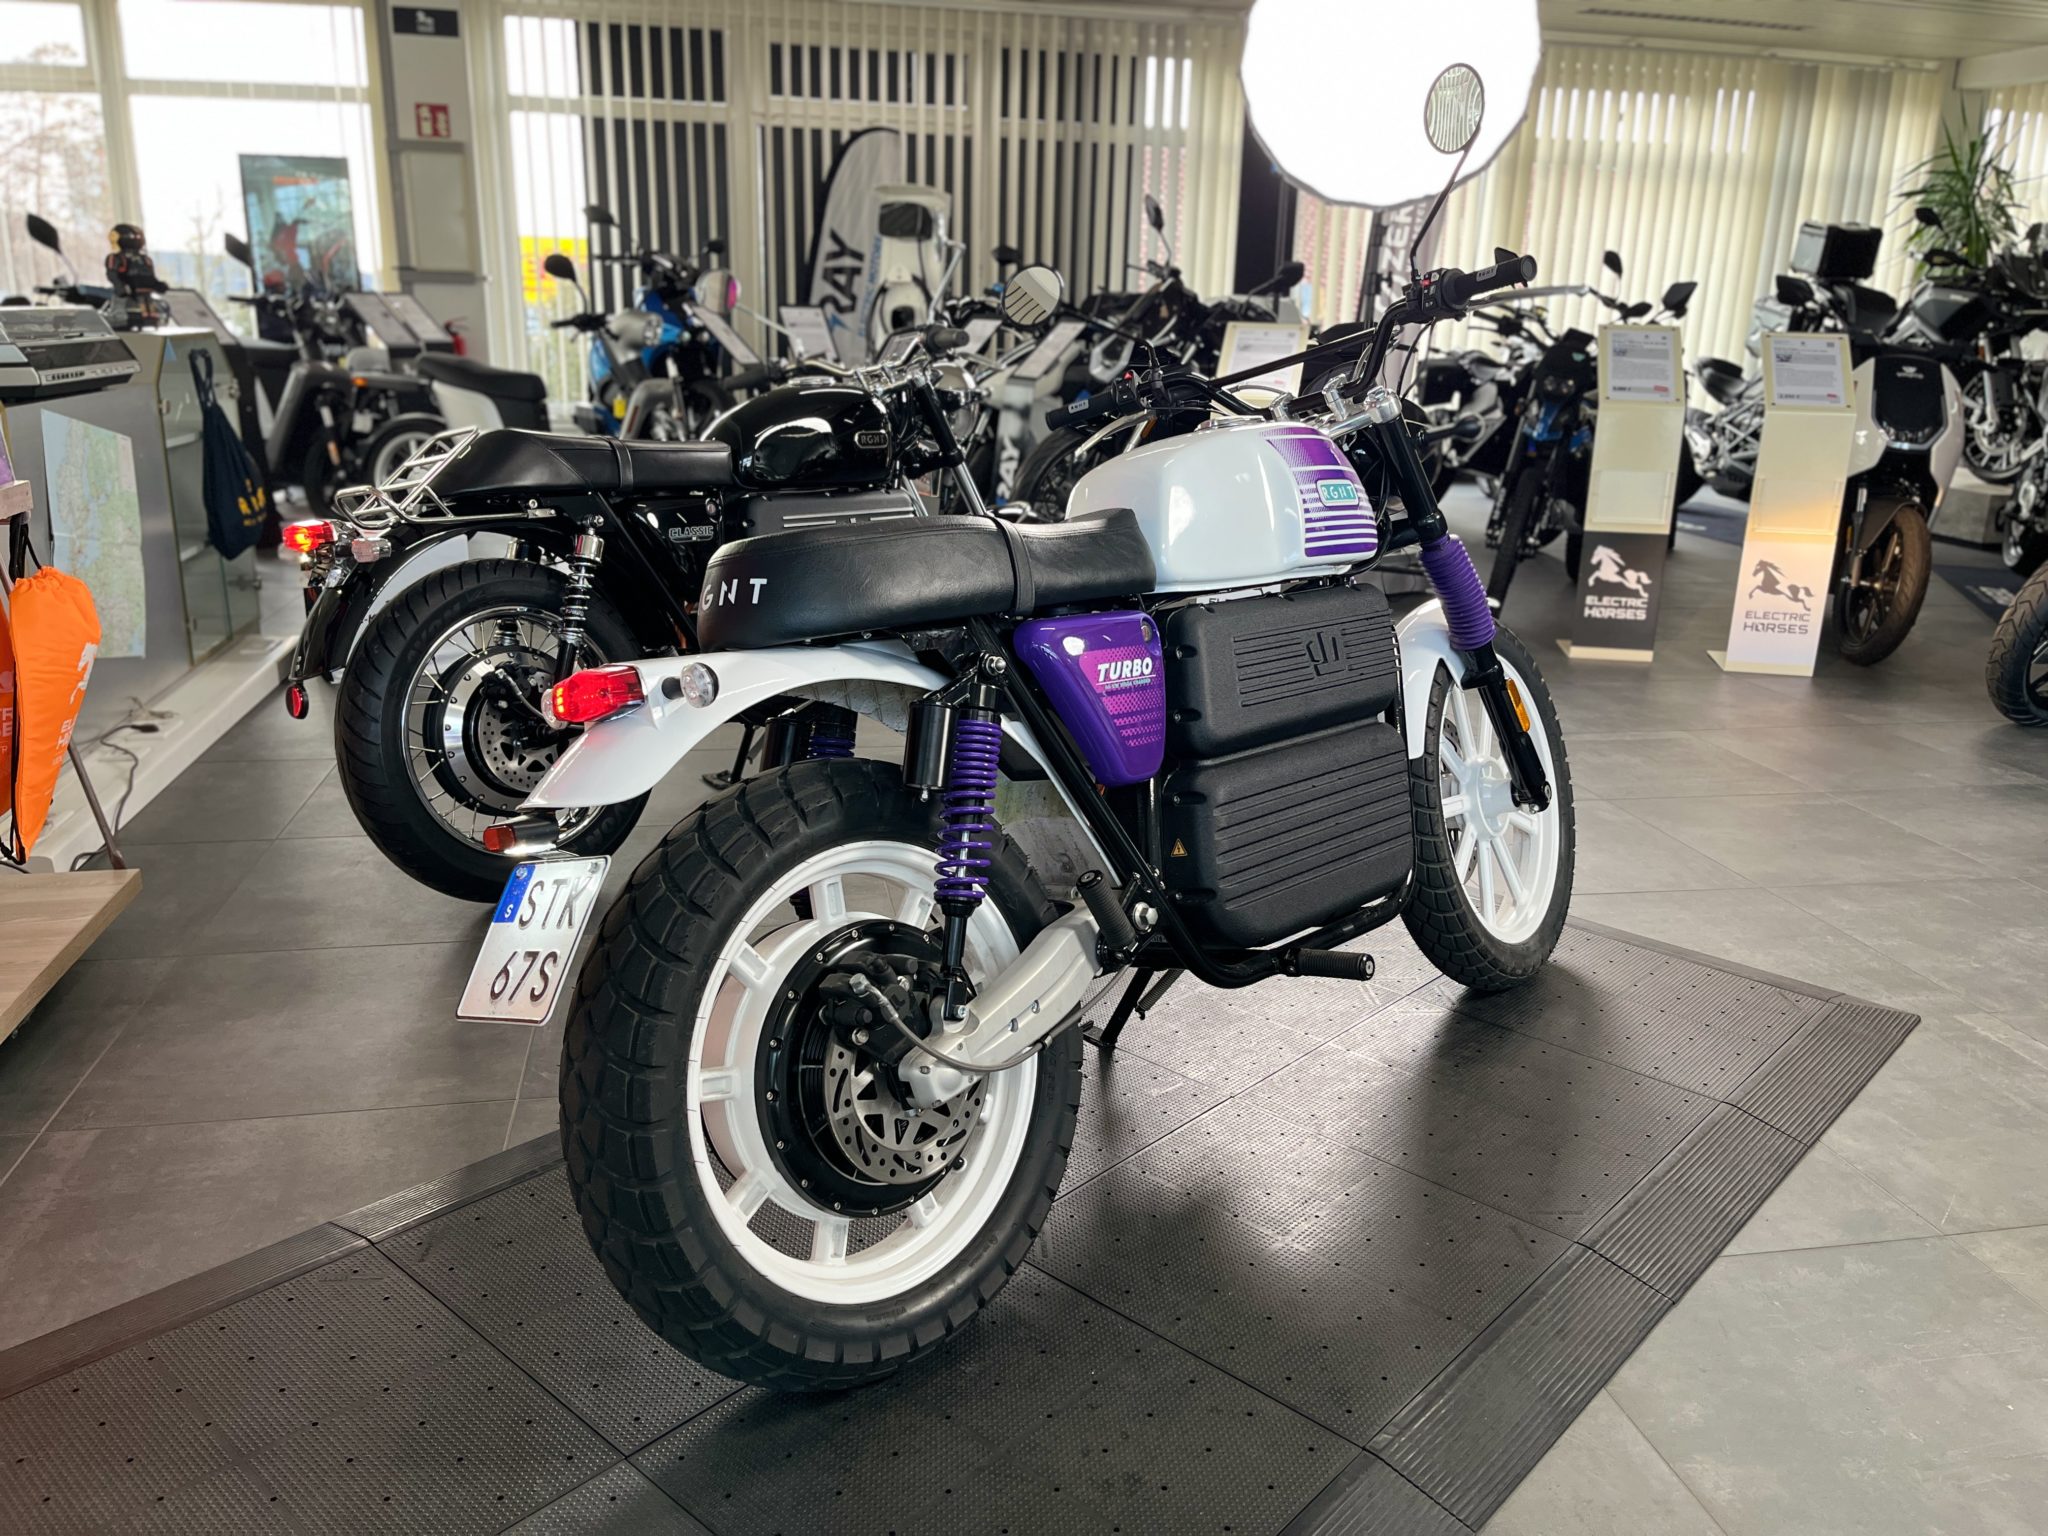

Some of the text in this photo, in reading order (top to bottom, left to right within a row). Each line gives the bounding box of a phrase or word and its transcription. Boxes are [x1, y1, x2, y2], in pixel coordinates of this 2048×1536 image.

[1382, 202, 1414, 272] ZER
[820, 228, 864, 314] RAY
[860, 434, 885, 445] RGNT
[1321, 486, 1355, 499] RGNT
[669, 525, 714, 538] CLASSIC
[701, 578, 768, 611] GNT
[1585, 595, 1648, 608] ELECTRIC
[1583, 606, 1647, 620] HORSES
[1745, 610, 1811, 622] ELECTRIC
[1743, 622, 1809, 634] HORSES
[1097, 657, 1153, 682] TURBO
[518, 877, 592, 930] STK
[504, 904, 514, 918] S
[490, 951, 559, 1003] 67S
